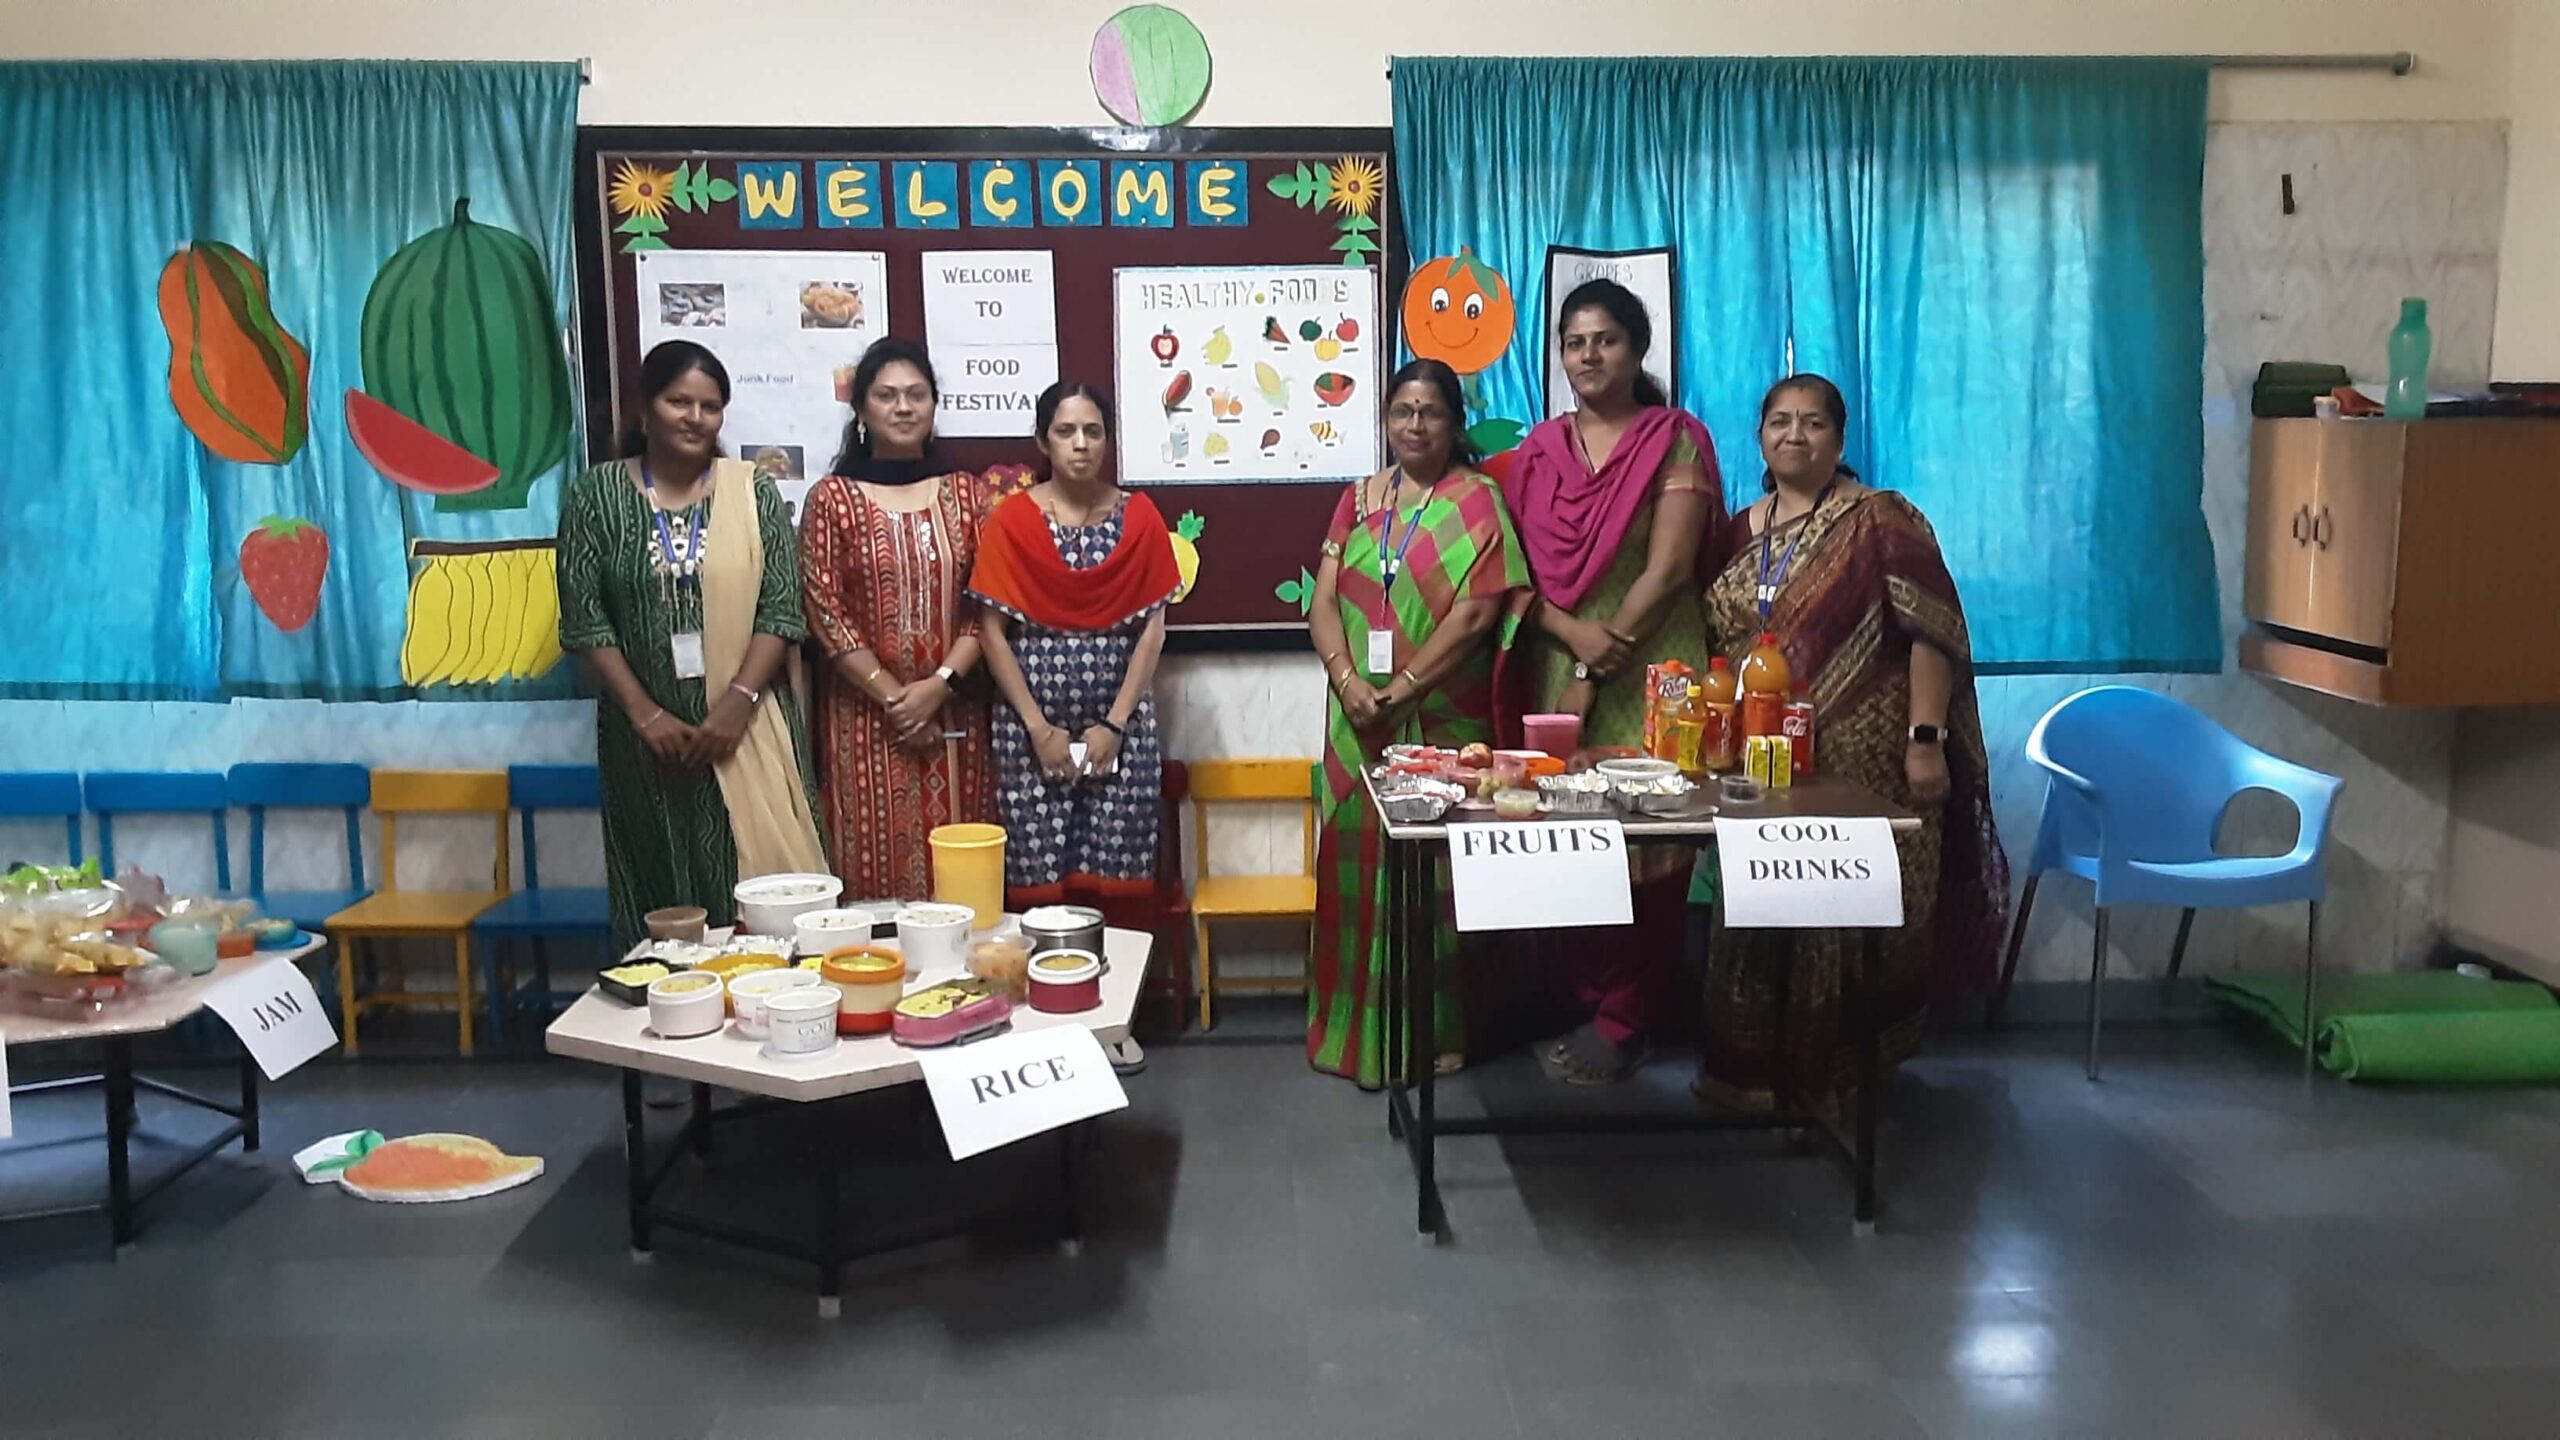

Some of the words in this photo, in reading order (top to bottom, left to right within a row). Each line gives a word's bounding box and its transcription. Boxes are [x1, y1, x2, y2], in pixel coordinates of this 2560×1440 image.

[744, 168, 1237, 219] WELCOME
[942, 267, 1033, 284] WELCOME
[1574, 262, 1633, 284] GRAPES
[1141, 281, 1255, 310] HEALTHY
[974, 301, 1003, 317] TO
[966, 359, 1020, 375] FOOD
[1463, 826, 1612, 857] FRUITS
[1758, 823, 1850, 843] COOL
[1749, 858, 1872, 881] DRINKS
[252, 991, 303, 1032] JAM
[970, 1056, 1076, 1105] RICE
